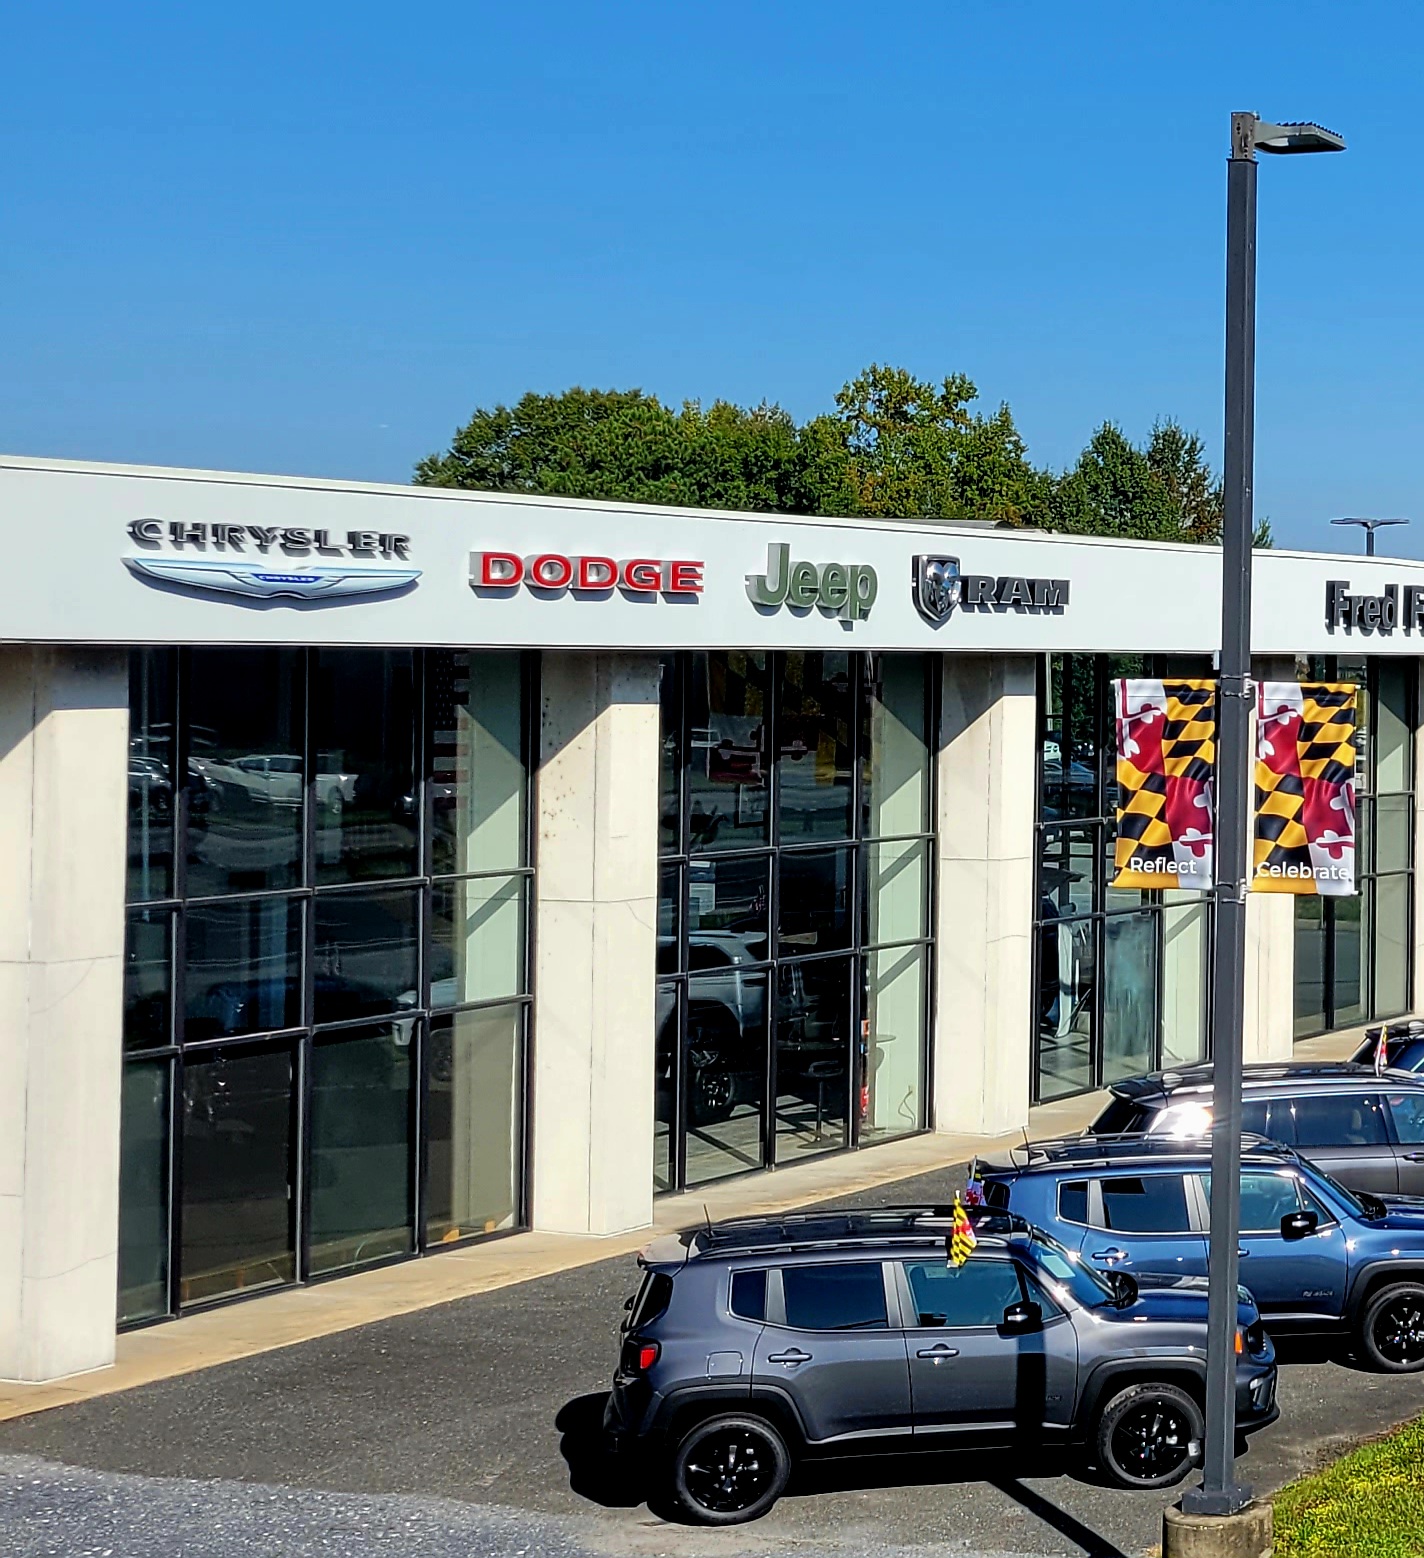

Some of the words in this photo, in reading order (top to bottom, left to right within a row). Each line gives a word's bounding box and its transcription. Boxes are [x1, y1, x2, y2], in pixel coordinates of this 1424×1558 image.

[126, 518, 411, 556] CHRYSLER
[470, 552, 705, 594] DODGE
[745, 542, 878, 622] Jeep
[961, 575, 1071, 607] RAM
[1325, 580, 1399, 630] Fred
[1129, 857, 1197, 875] Reflect
[1256, 861, 1350, 880] Celebrate
